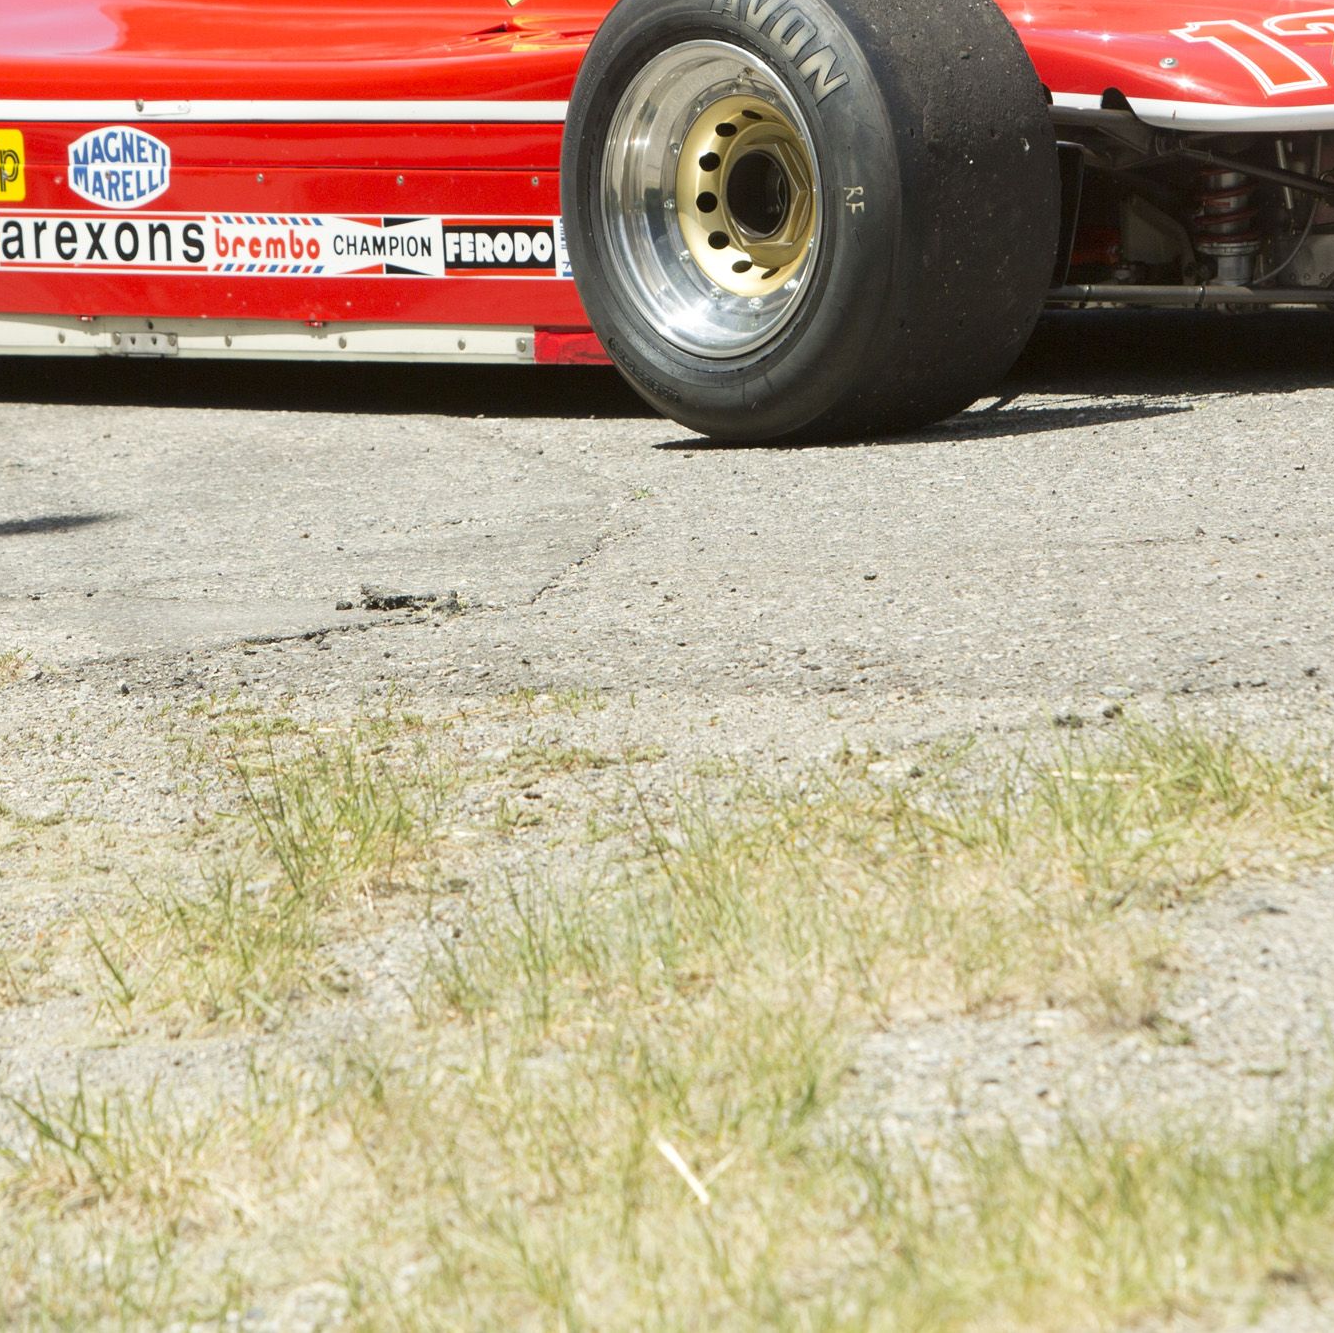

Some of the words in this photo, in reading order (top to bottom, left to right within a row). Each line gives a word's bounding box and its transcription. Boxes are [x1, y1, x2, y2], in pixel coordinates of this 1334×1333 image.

[72, 130, 167, 165] MAGNETI
[72, 166, 167, 203] MARELLI
[843, 186, 865, 215] RF
[2, 218, 205, 264] arexons
[215, 228, 320, 260] brembo
[333, 234, 431, 258] CHAMPION
[446, 231, 553, 263] FERODO
